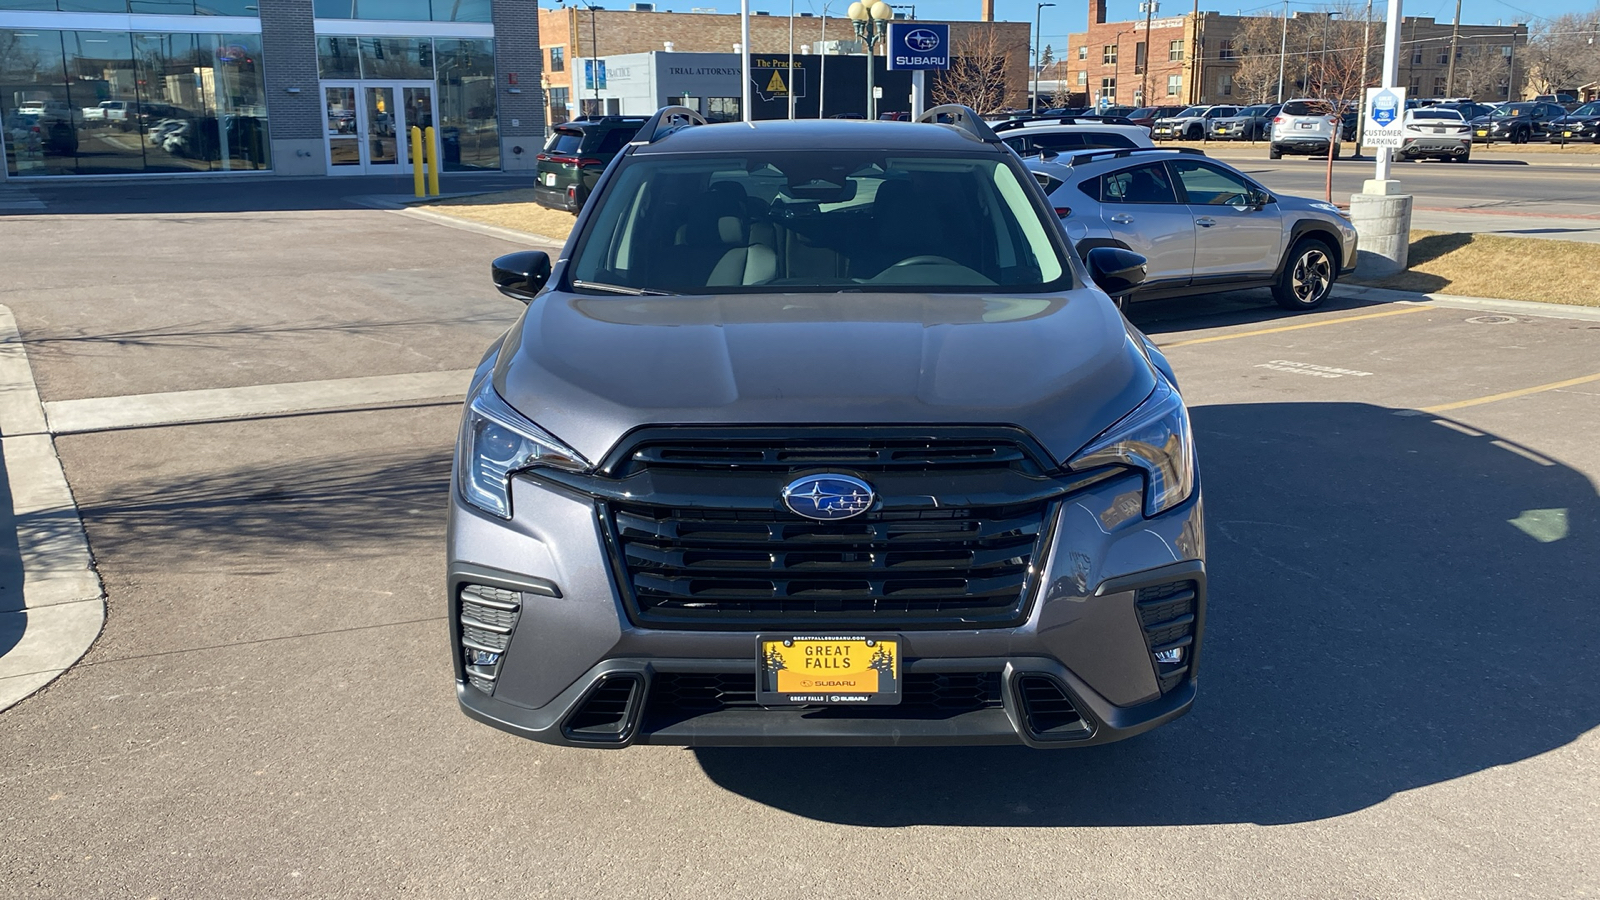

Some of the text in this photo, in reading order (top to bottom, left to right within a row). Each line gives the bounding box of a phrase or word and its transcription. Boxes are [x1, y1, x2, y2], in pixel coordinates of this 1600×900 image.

[756, 59, 802, 68] The Pracce
[896, 56, 945, 65] SUBARU
[669, 67, 742, 75] TRIAL ATTORNEYS
[805, 645, 851, 656] GREAT
[805, 657, 851, 669] FALLS
